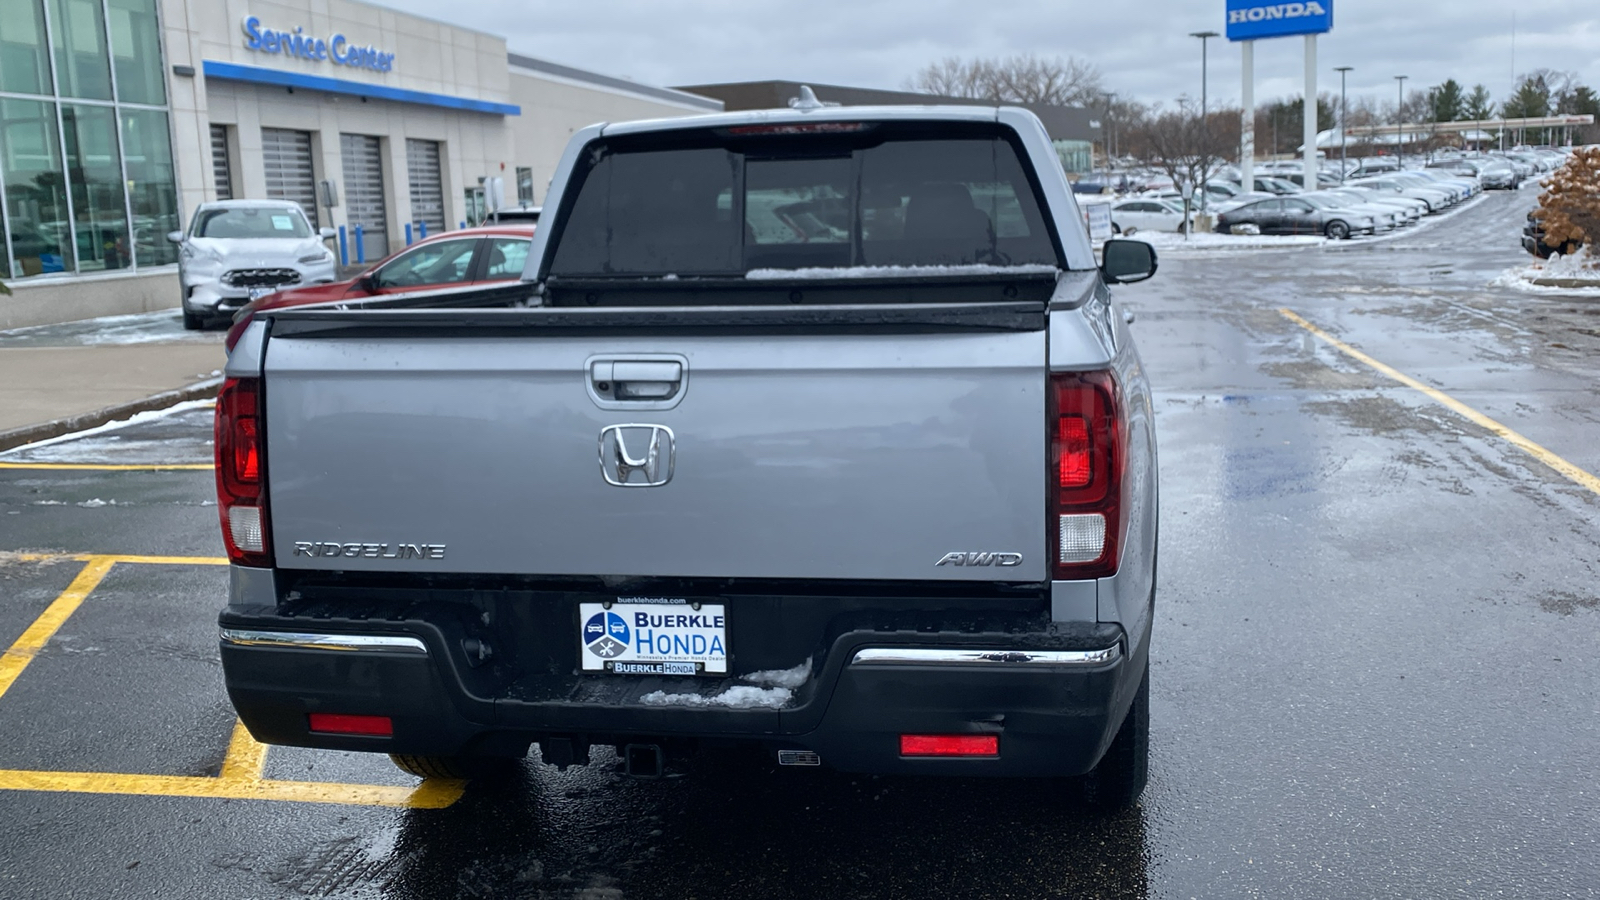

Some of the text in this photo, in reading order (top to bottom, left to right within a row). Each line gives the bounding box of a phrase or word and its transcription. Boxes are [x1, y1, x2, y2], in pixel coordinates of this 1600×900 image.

[1228, 1, 1326, 24] HONDA
[242, 16, 395, 72] Service Center
[294, 541, 446, 559] RIDGELINE
[934, 551, 1023, 567] AWD
[617, 597, 687, 605] buerklehonda.com
